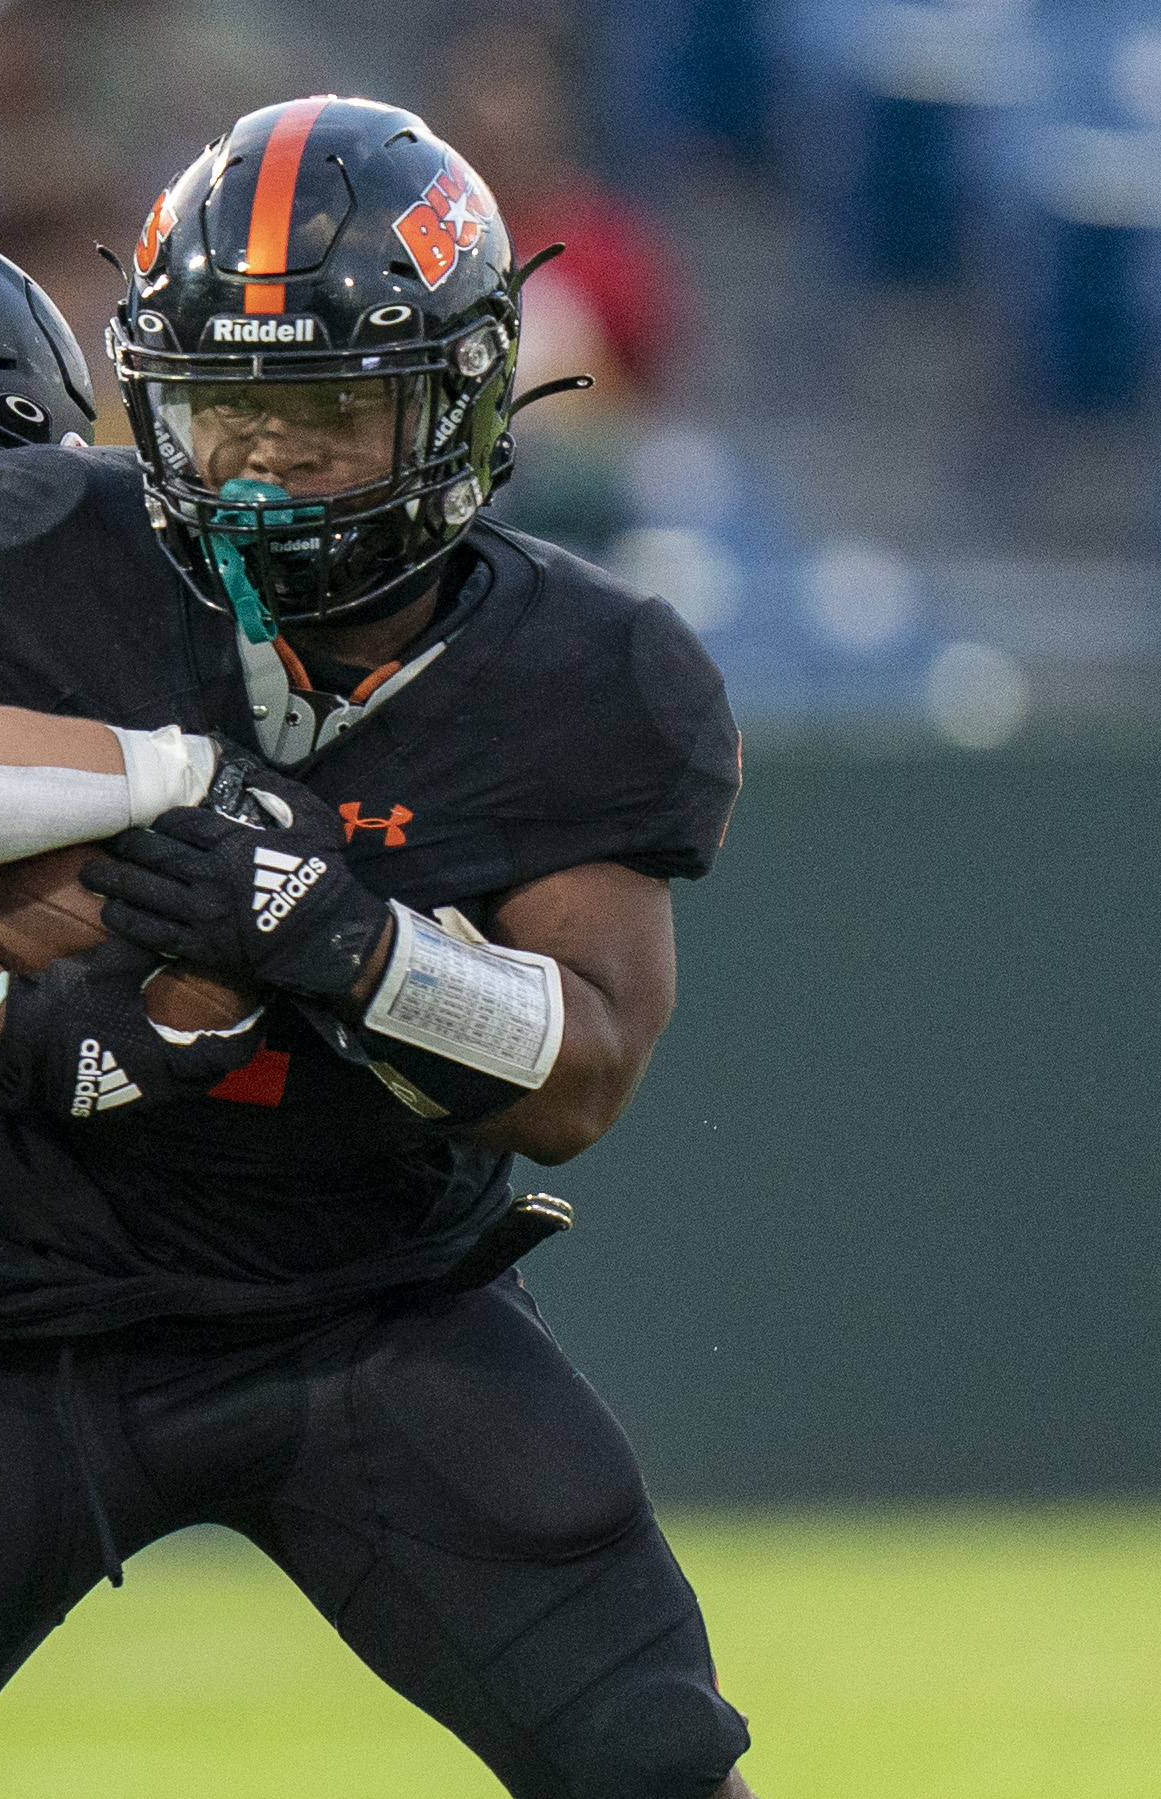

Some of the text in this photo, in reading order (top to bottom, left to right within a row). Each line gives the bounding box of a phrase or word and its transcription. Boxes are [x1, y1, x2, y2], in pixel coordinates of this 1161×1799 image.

[213, 319, 314, 342] Riddell
[270, 537, 321, 554] Riddell
[256, 856, 328, 932] adidas
[70, 1038, 101, 1118] adidas
